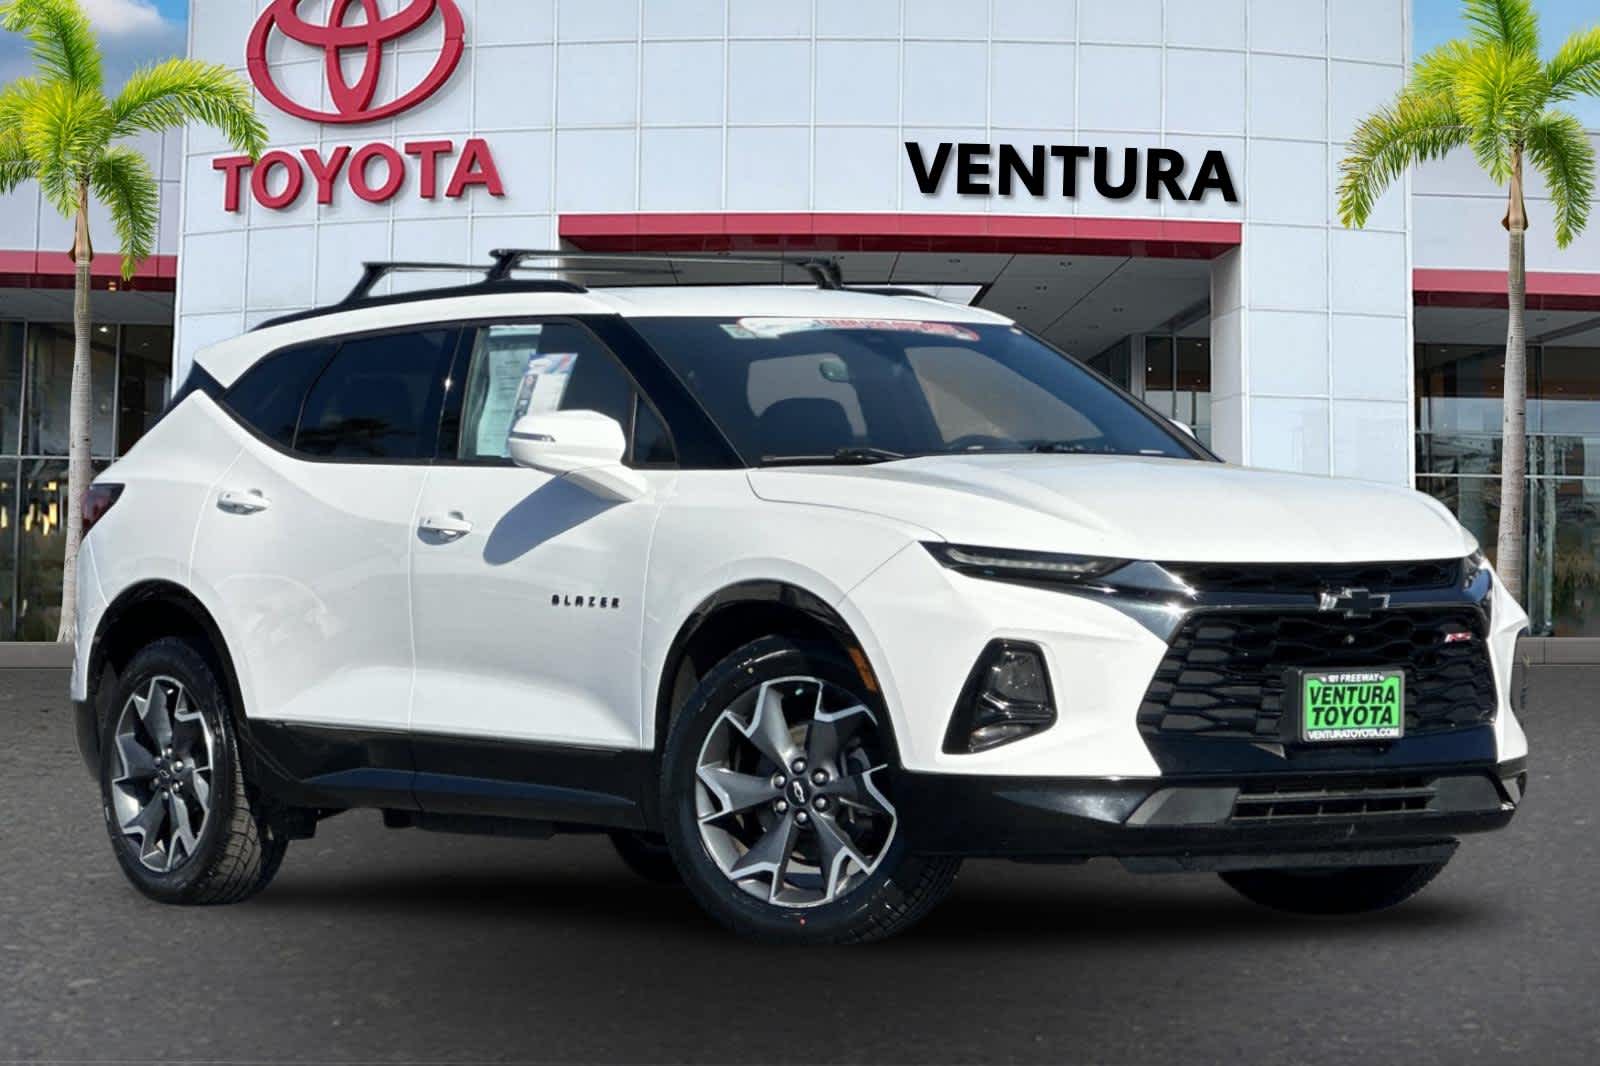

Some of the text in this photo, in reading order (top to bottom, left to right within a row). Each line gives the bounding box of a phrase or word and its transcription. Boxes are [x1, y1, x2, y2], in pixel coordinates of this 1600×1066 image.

[212, 138, 505, 212] TOYOTA
[904, 141, 1239, 203] VENTURA
[551, 594, 620, 608] BLAZER
[1340, 673, 1380, 682] FREEWAY
[1309, 685, 1396, 705] VENTURA
[1311, 705, 1393, 726] TOYOTA
[1307, 727, 1400, 740] VENTURATOYOTA.COM
